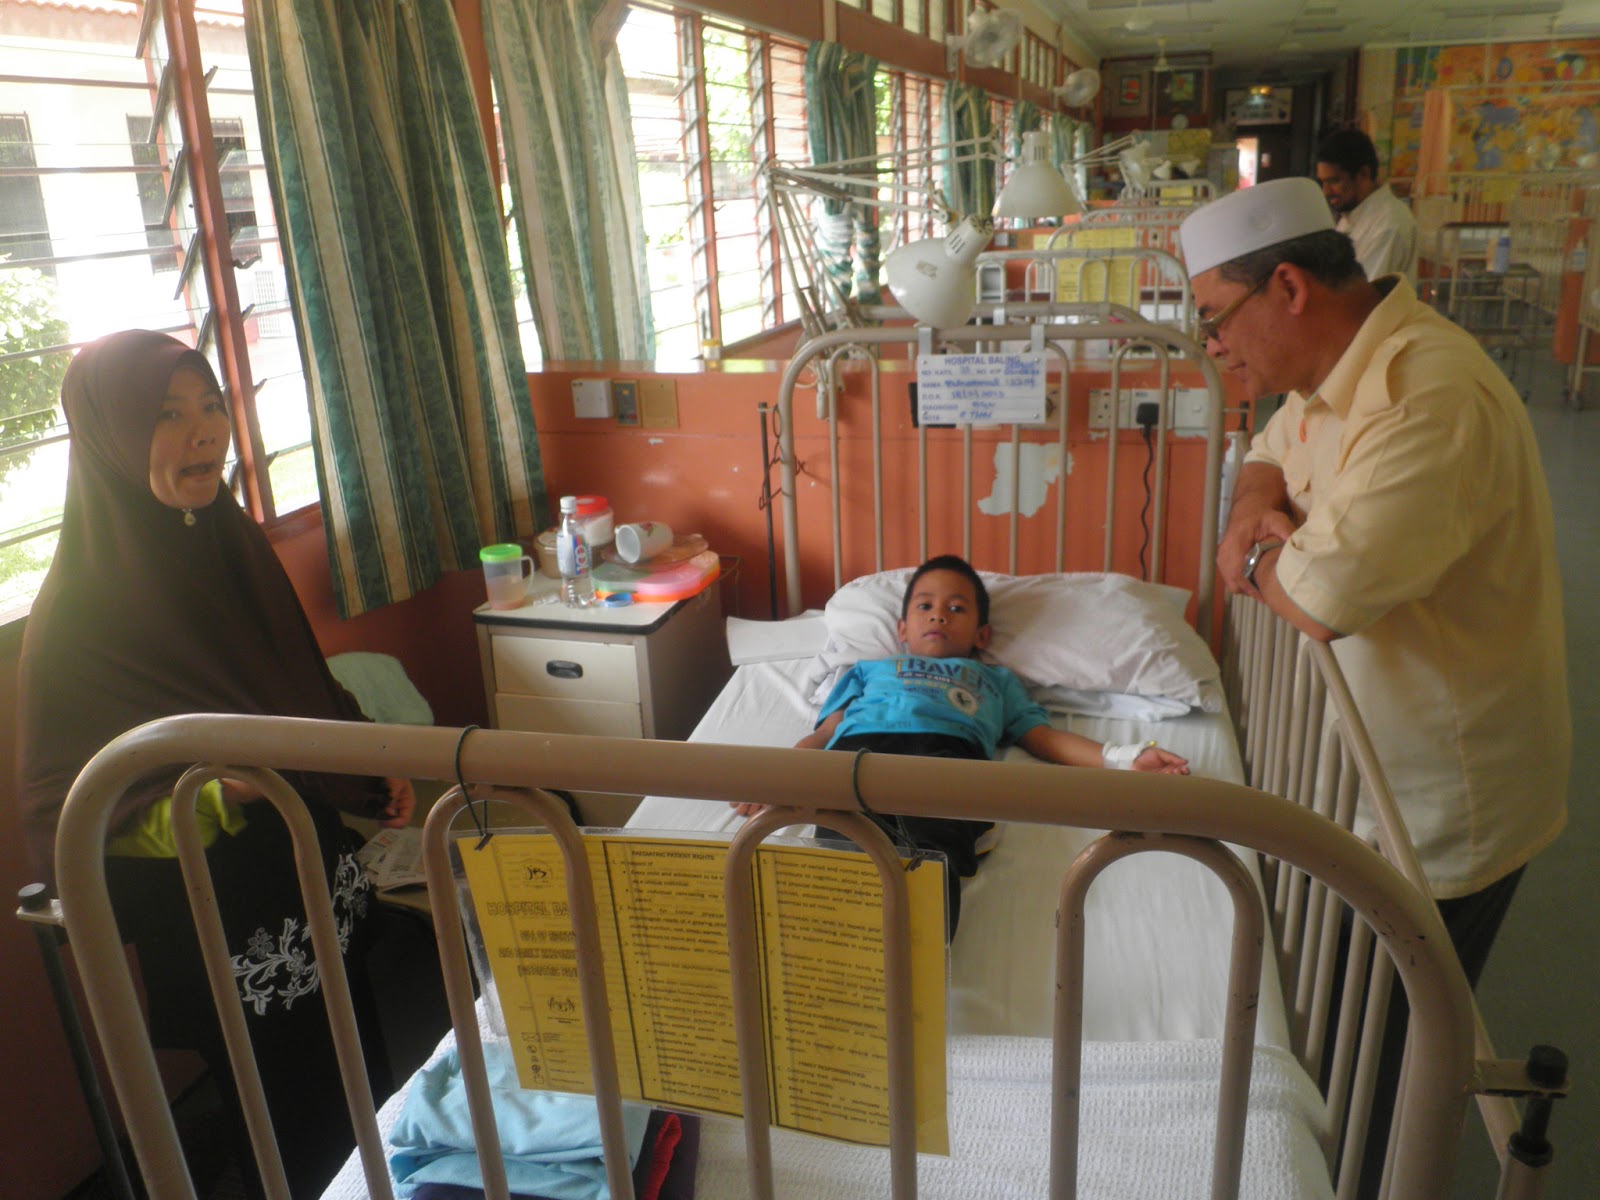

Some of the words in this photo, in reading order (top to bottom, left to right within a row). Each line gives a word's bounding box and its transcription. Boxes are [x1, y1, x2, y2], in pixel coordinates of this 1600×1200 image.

[944, 356, 986, 366] HOSPITAL
[631, 850, 665, 858] PAEDIATRIC
[666, 852, 691, 860] PATIENT
[692, 853, 715, 861] RIGHTS
[485, 901, 551, 916] HOSPITAL
